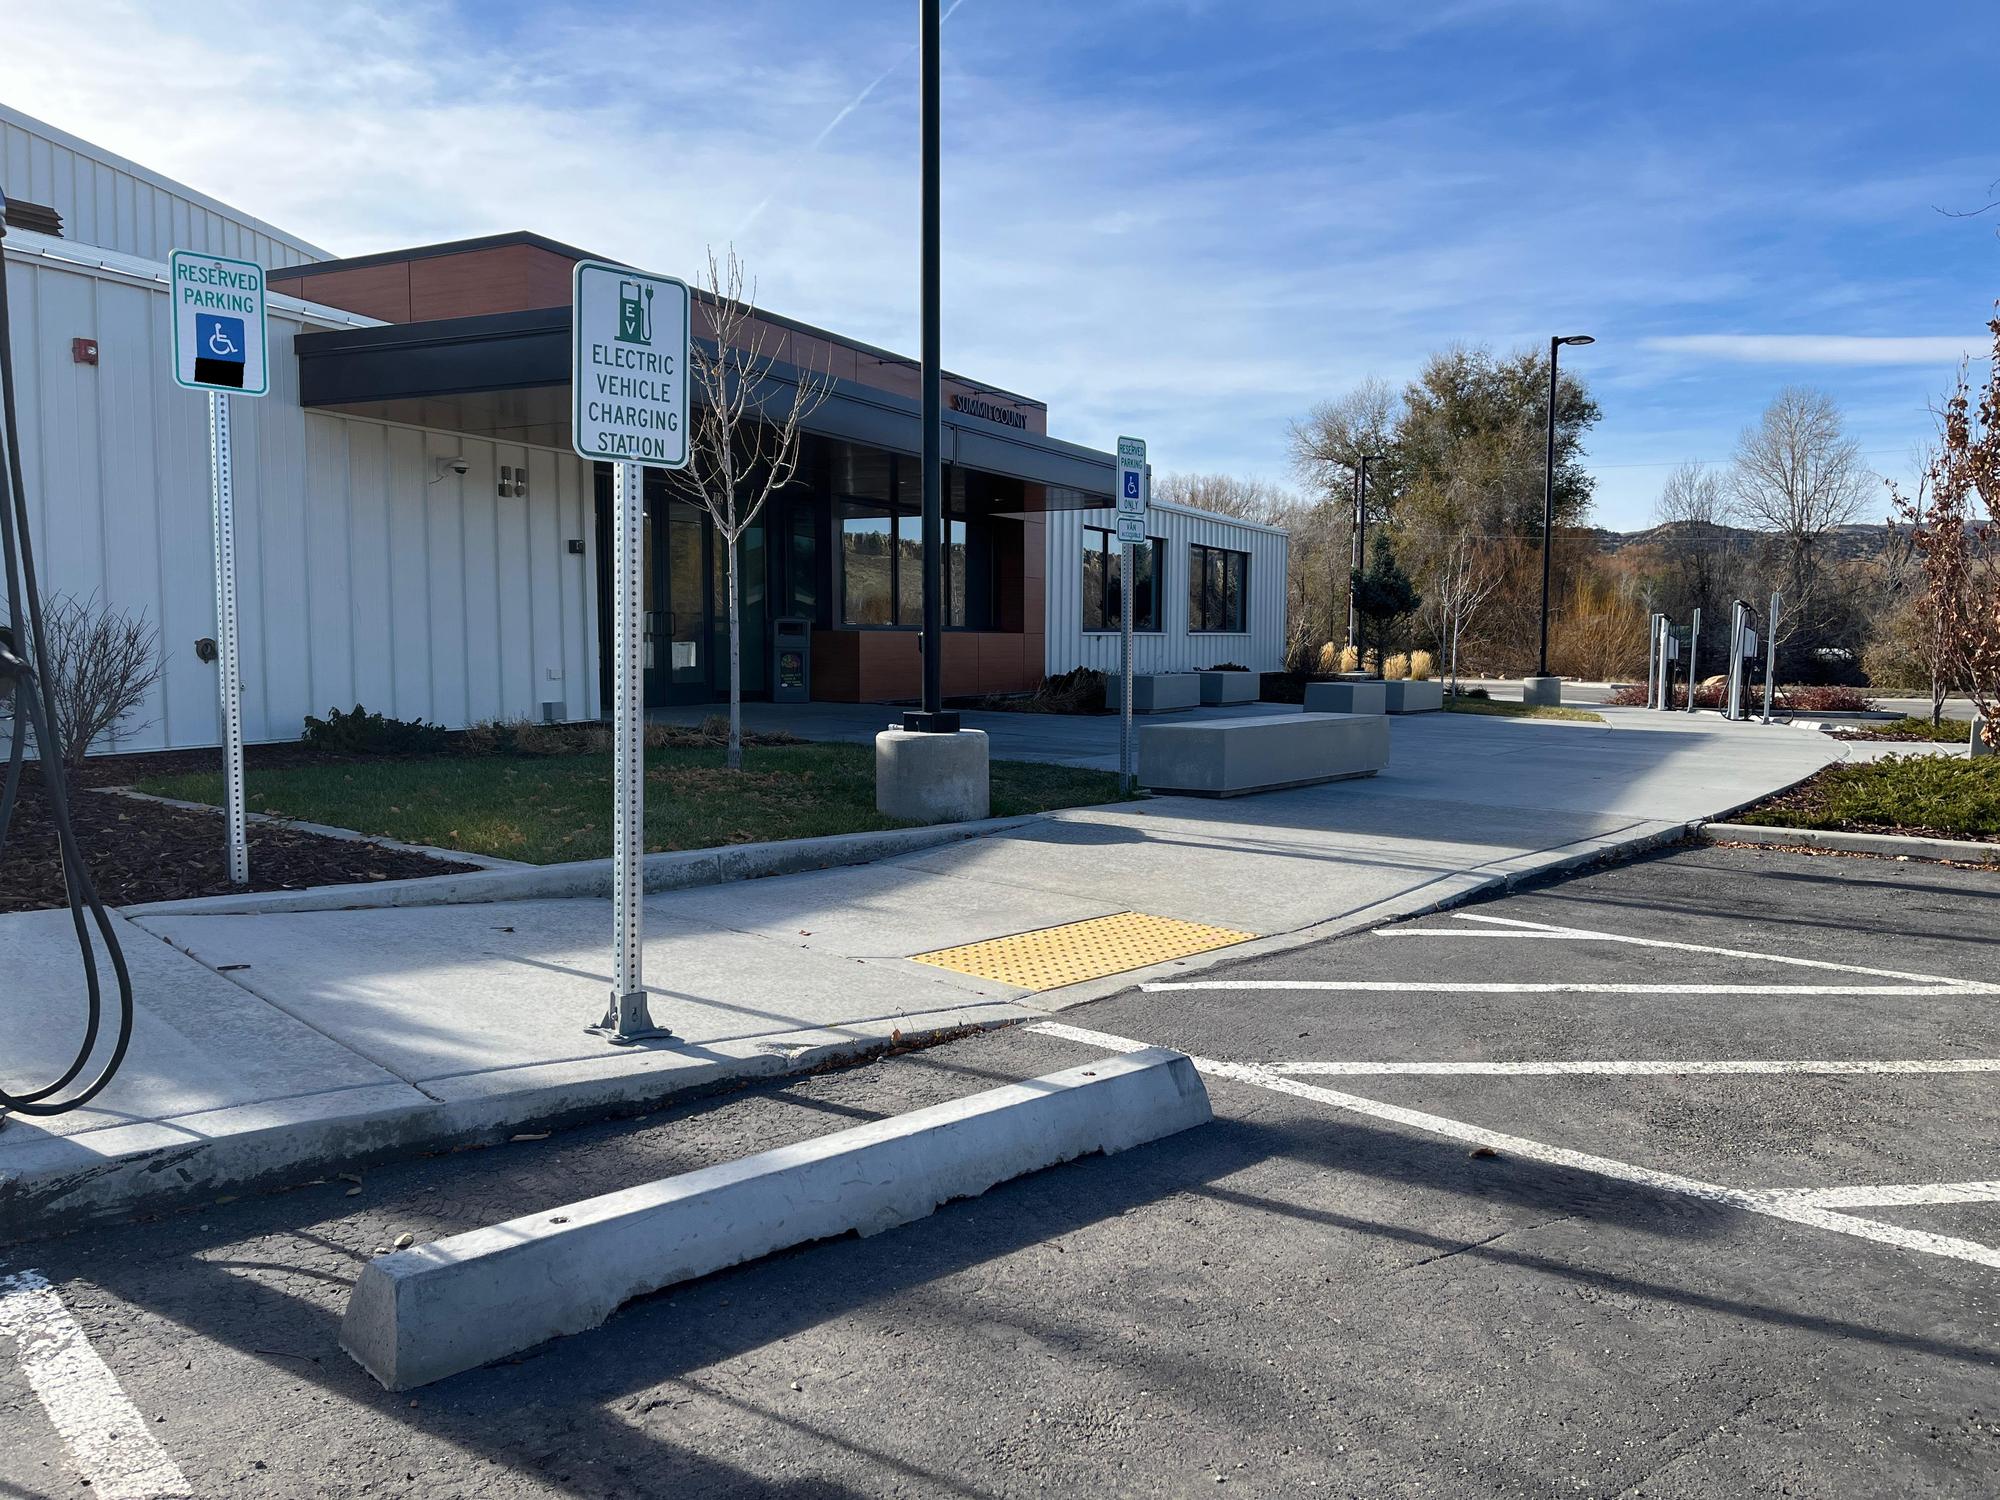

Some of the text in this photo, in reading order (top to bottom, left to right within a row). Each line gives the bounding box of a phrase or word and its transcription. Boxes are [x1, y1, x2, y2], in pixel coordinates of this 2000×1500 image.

[178, 263, 258, 291] RESERVED
[184, 287, 254, 313] PARKING
[592, 343, 674, 375] ELECTRIC
[596, 373, 671, 403] VEHICLE
[588, 402, 678, 431] CHARGING
[597, 431, 665, 458] STATION
[1119, 443, 1144, 457] RESERVED
[1120, 457, 1143, 469] PARKING
[1124, 498, 1139, 510] ONLY
